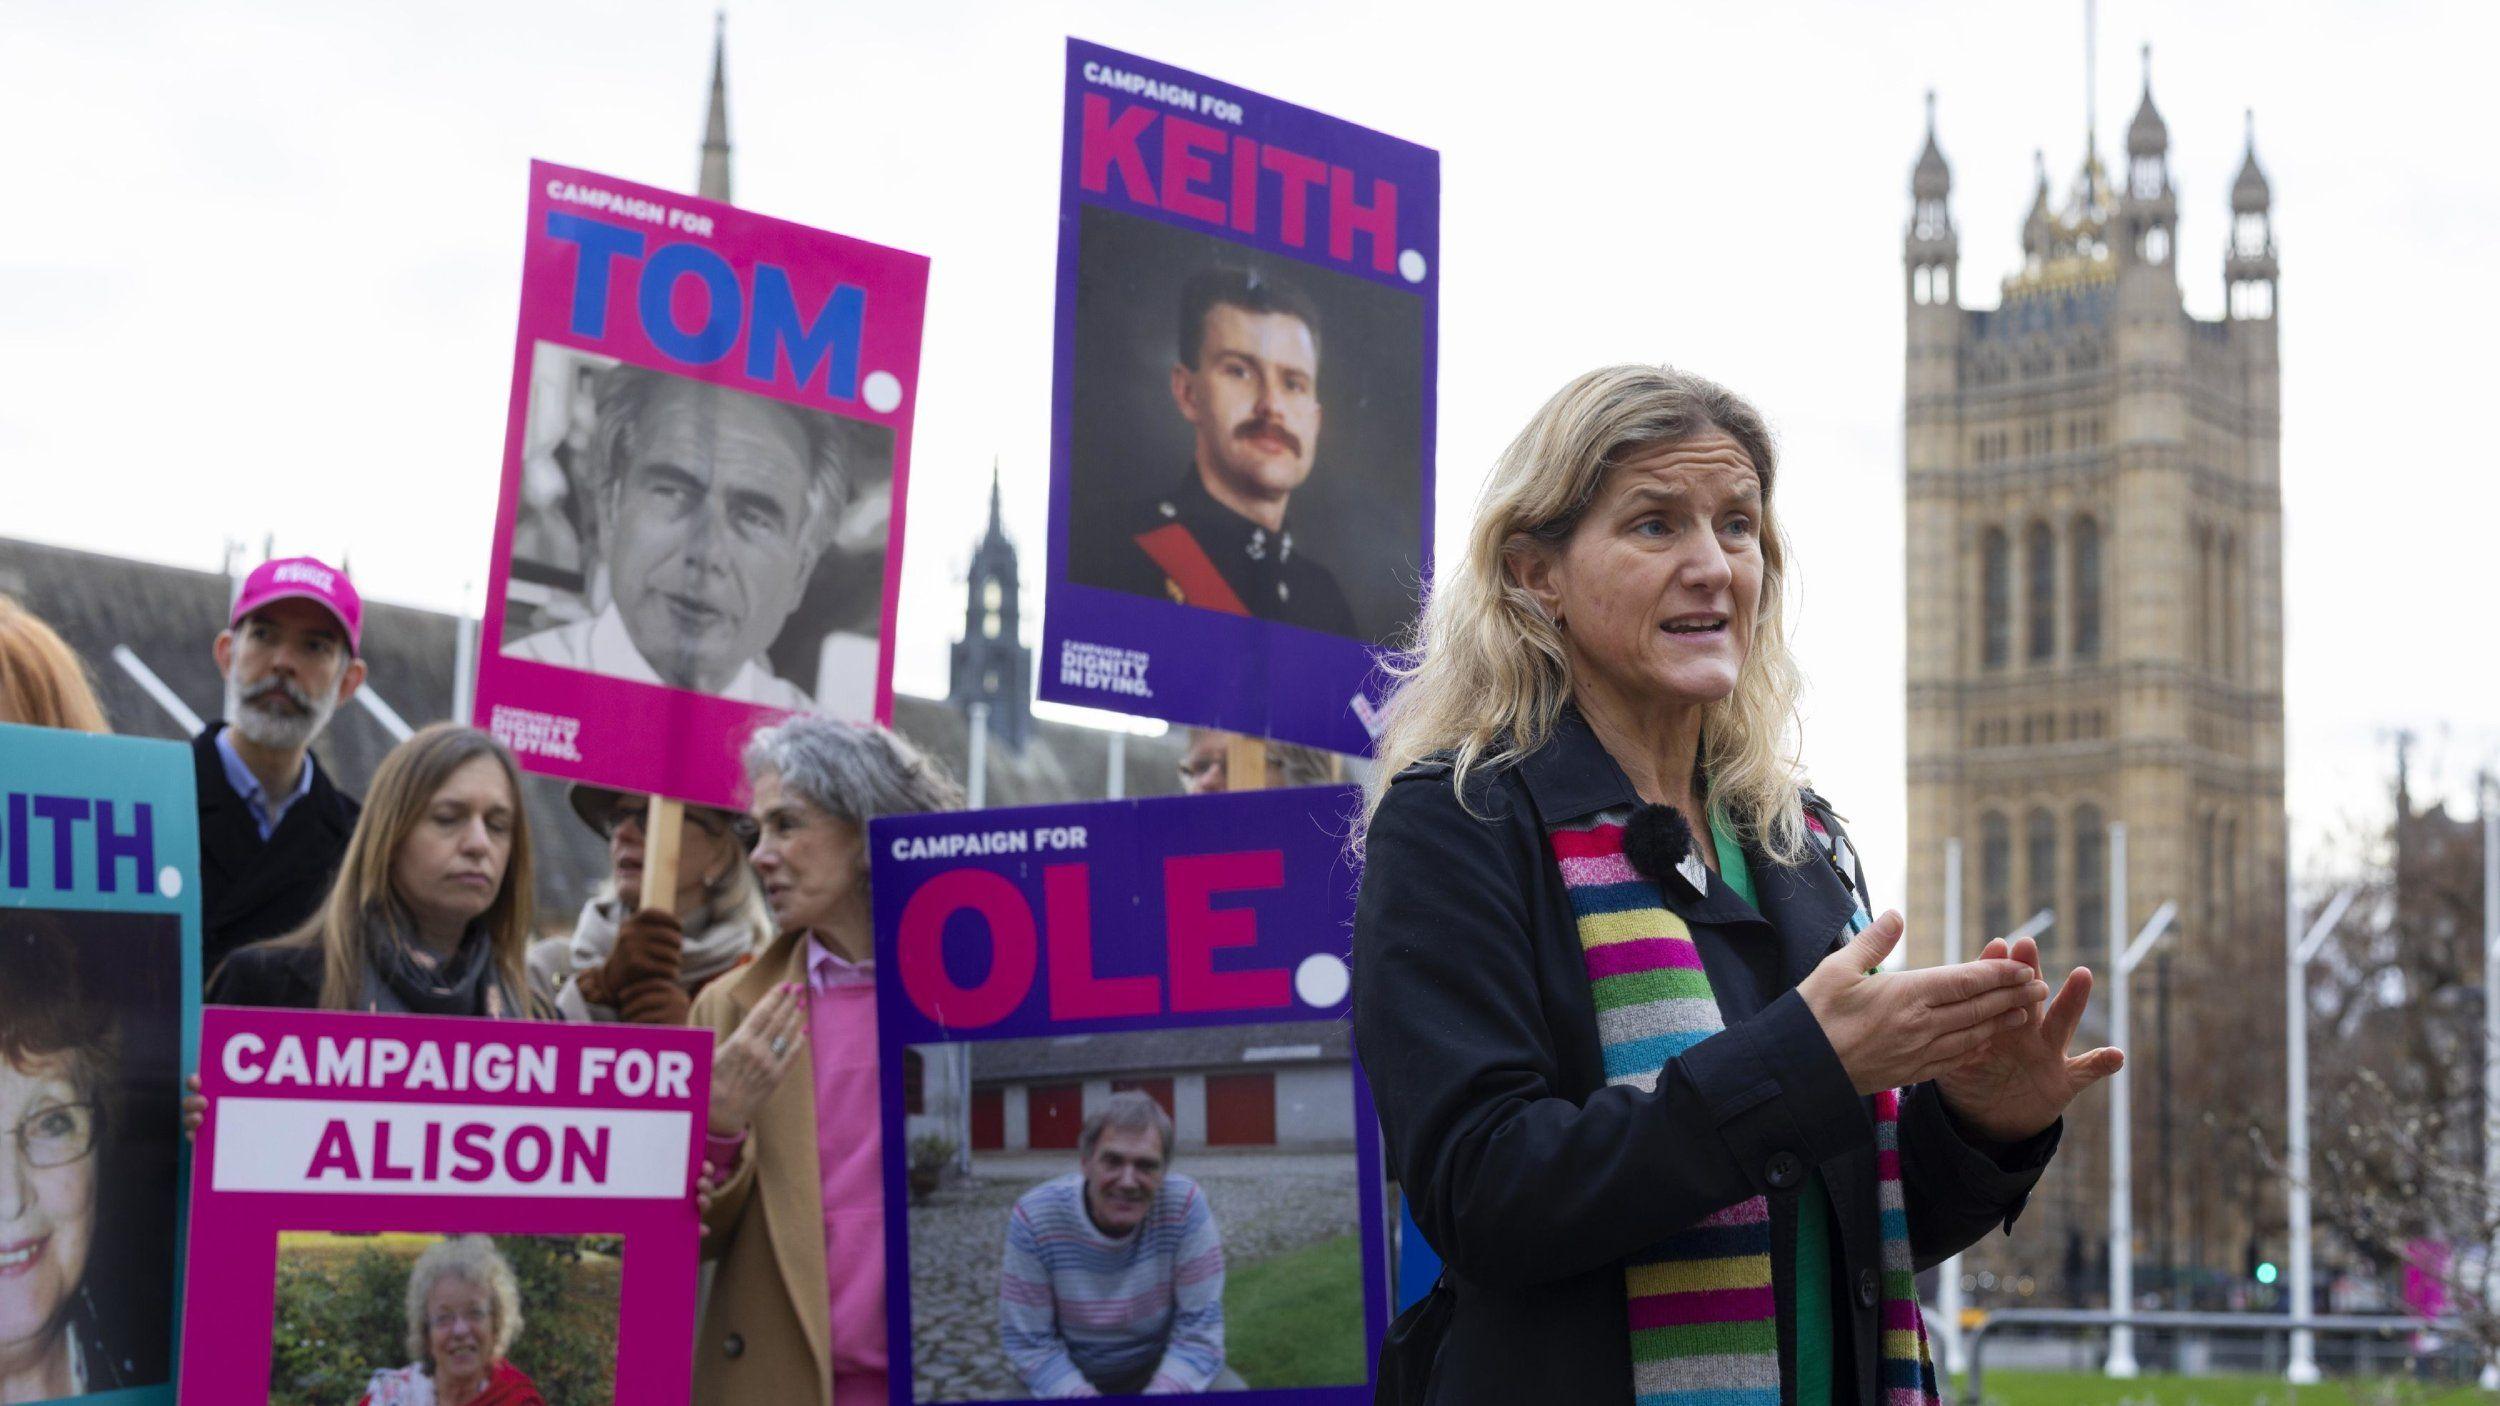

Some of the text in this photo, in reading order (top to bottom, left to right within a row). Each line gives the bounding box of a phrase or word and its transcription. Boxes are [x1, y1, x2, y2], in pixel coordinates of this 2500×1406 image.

[1083, 62, 1244, 125] CAMPAIGN FOR
[546, 180, 714, 238] CAMPAIGN FOR
[1080, 92, 1428, 284] KEITH.
[546, 210, 902, 413] TOM.
[1061, 668, 1154, 698] IN DYING.
[1062, 650, 1149, 678] DIGNITY
[491, 712, 580, 742] DIGNITY
[513, 734, 583, 762] DYING.
[0, 792, 182, 898] ITH.
[892, 826, 1088, 860] CAMPAIGN FOR
[897, 850, 1350, 1029] OLE.
[221, 1032, 694, 1098] CAMPAIGN FOR
[305, 1119, 610, 1184] ALISON
